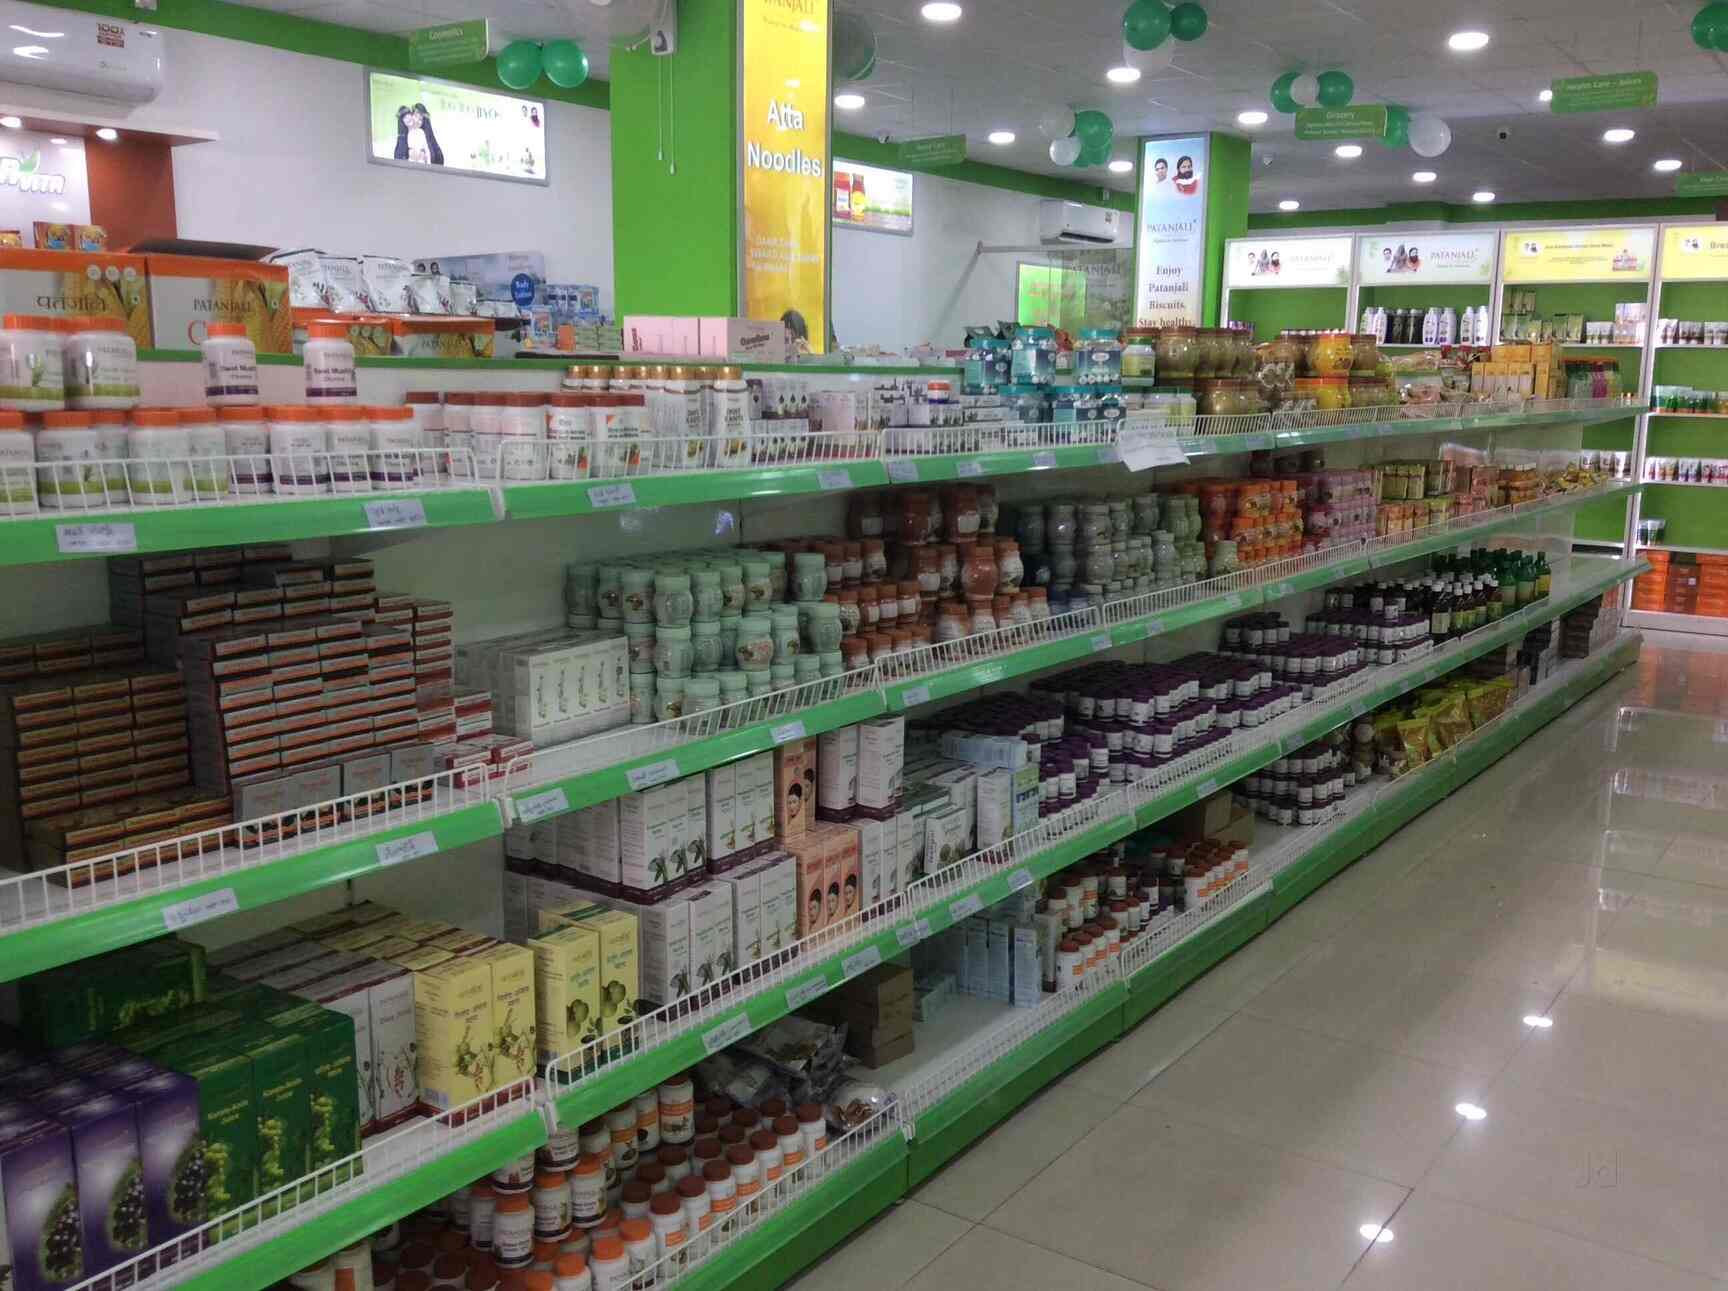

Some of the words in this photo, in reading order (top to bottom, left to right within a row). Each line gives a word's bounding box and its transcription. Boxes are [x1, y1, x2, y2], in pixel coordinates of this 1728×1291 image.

[767, 97, 804, 131] Atta
[747, 141, 822, 178] Noodles
[1147, 222, 1194, 233] PATANJALI
[1156, 265, 1184, 277] Enjoy
[1148, 282, 1189, 294] Patanjali
[192, 298, 253, 313] PATANJALI
